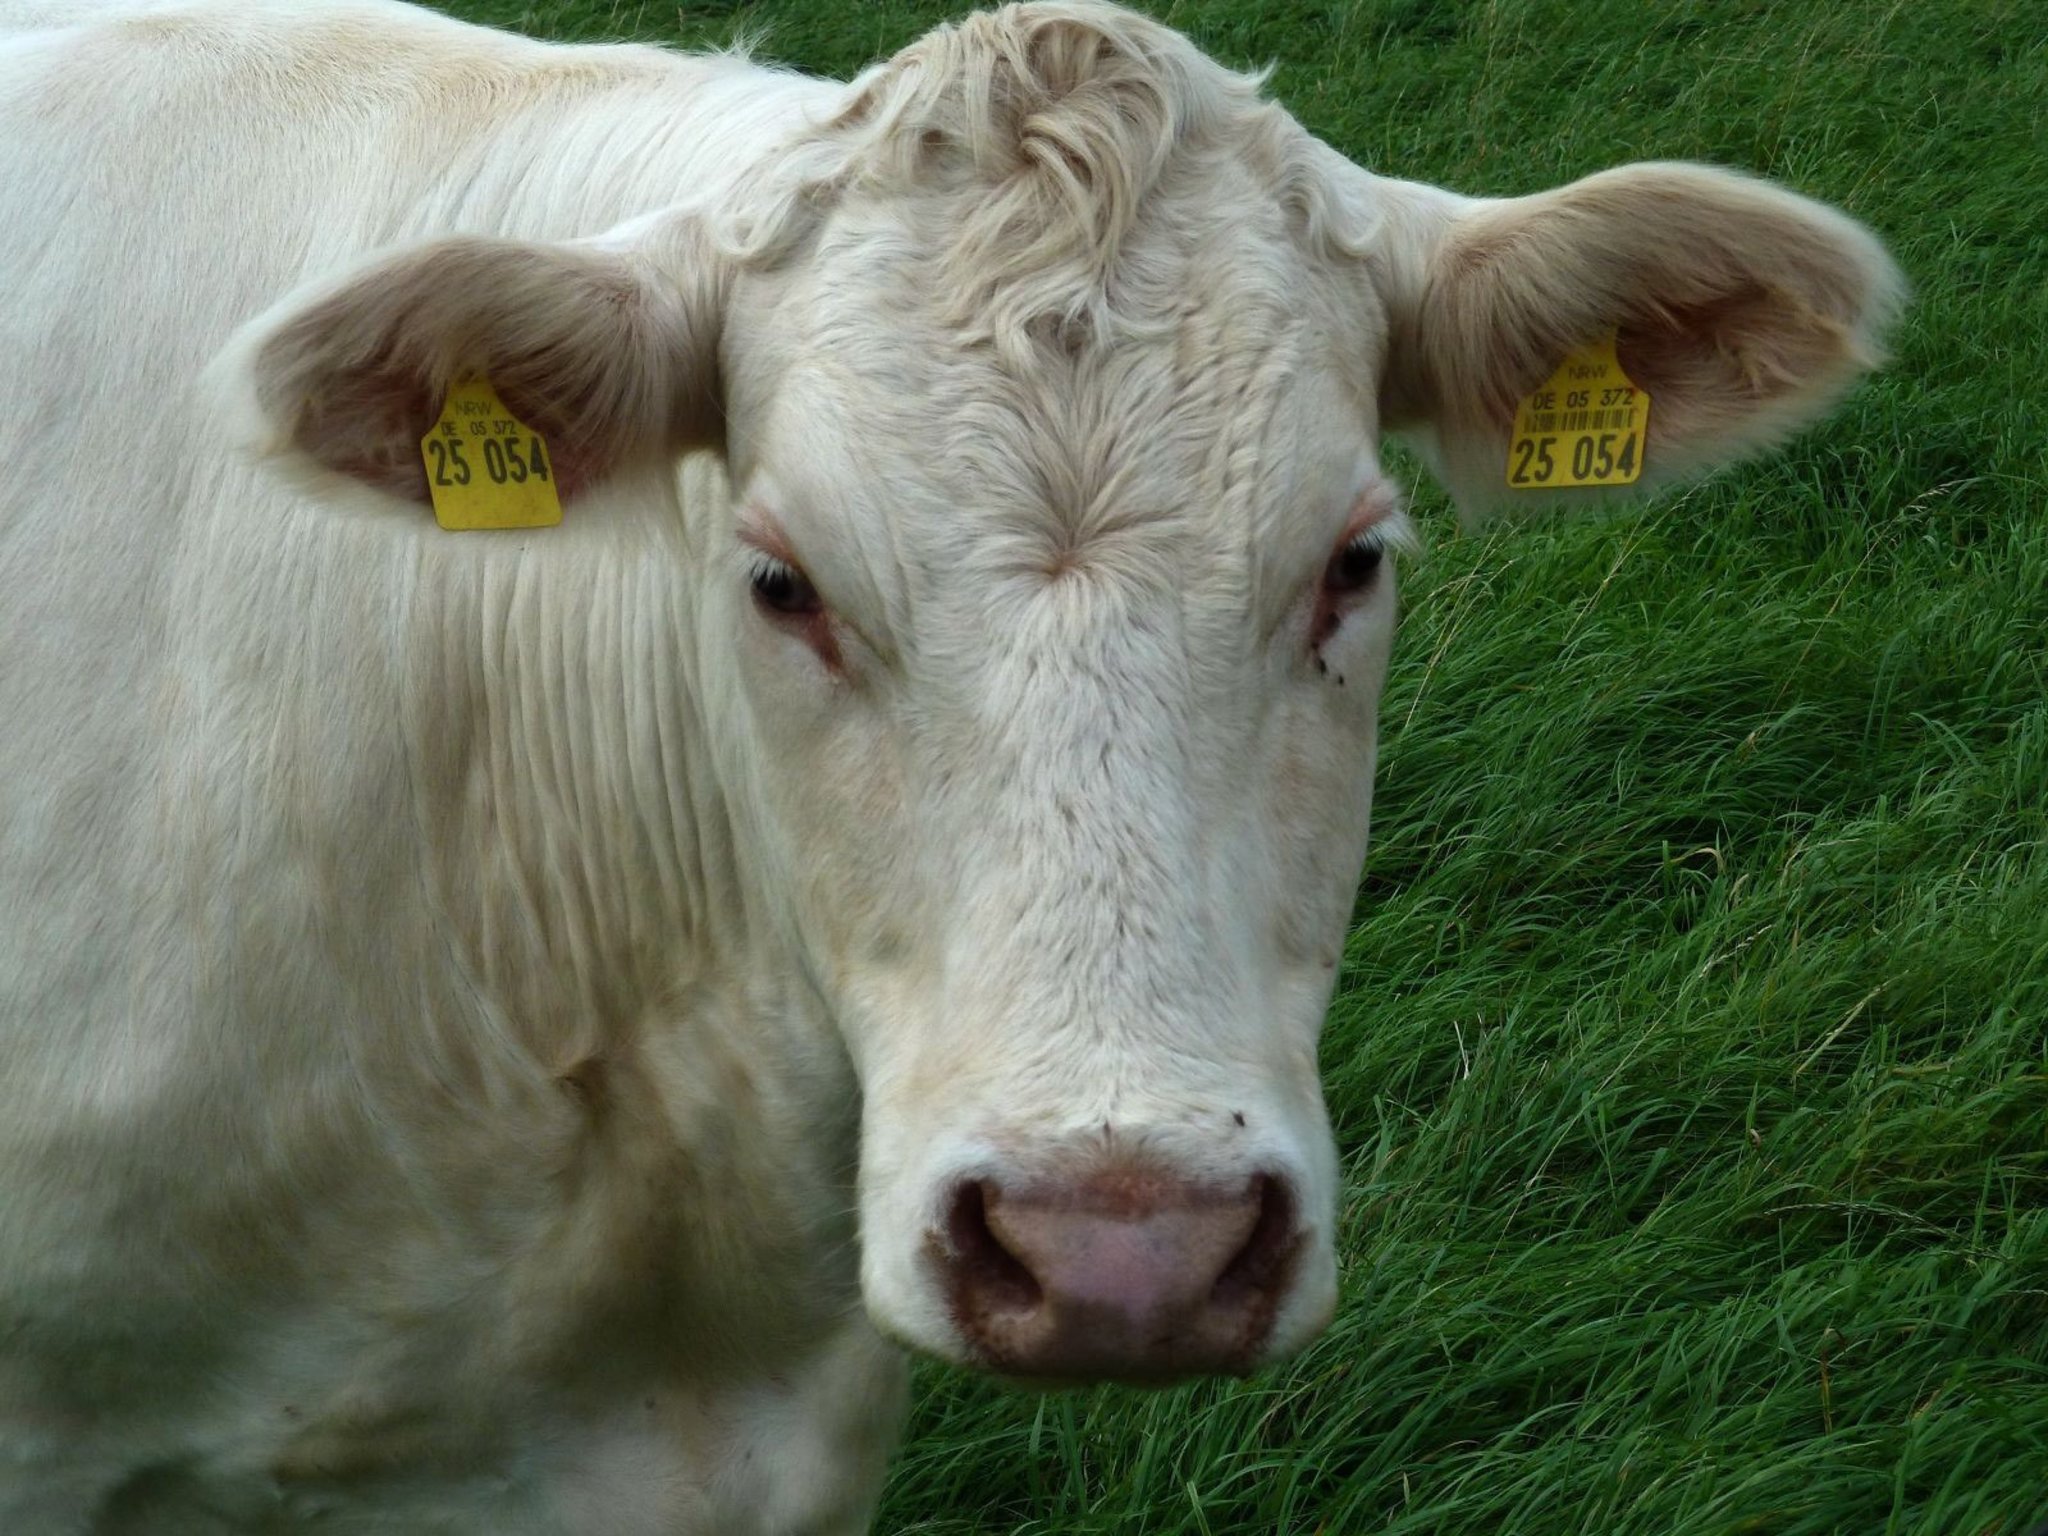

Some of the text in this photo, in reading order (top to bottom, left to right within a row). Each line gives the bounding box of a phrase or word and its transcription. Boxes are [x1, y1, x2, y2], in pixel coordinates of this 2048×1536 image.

[1568, 365, 1608, 379] NRW
[1533, 387, 1634, 410] DE 05 372
[470, 420, 486, 435] 05
[492, 420, 517, 435] 372
[428, 436, 548, 486] 25 054
[1512, 433, 1637, 484] 25 054
